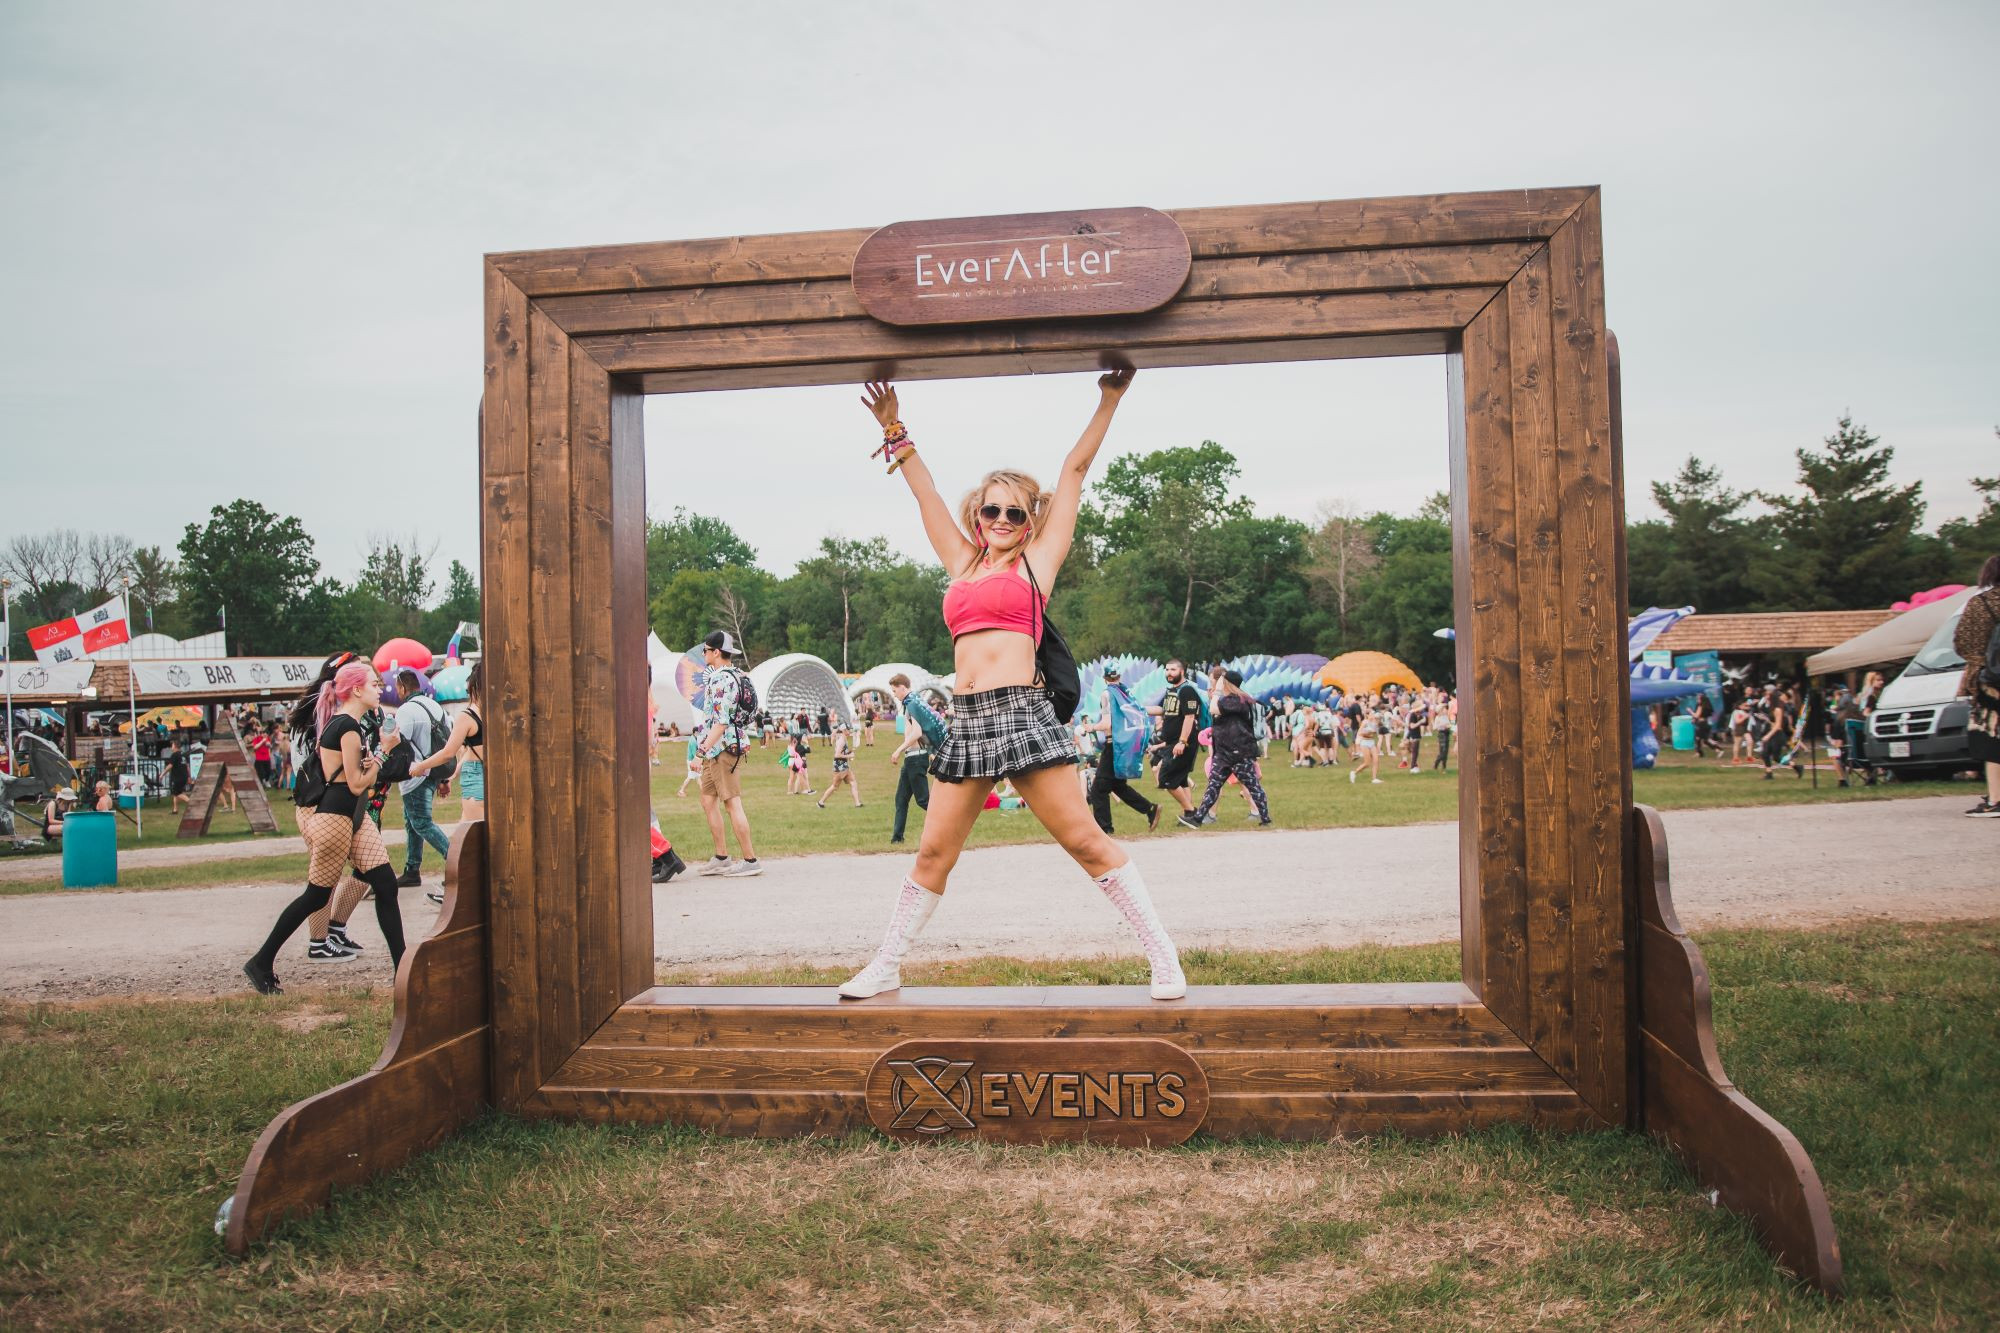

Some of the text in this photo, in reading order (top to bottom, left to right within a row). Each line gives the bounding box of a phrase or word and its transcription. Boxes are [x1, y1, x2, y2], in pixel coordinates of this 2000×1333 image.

[915, 242, 1121, 287] EverAfter
[203, 665, 237, 685] BAR
[282, 664, 311, 682] BAR
[981, 1072, 1187, 1118] EVENTS
